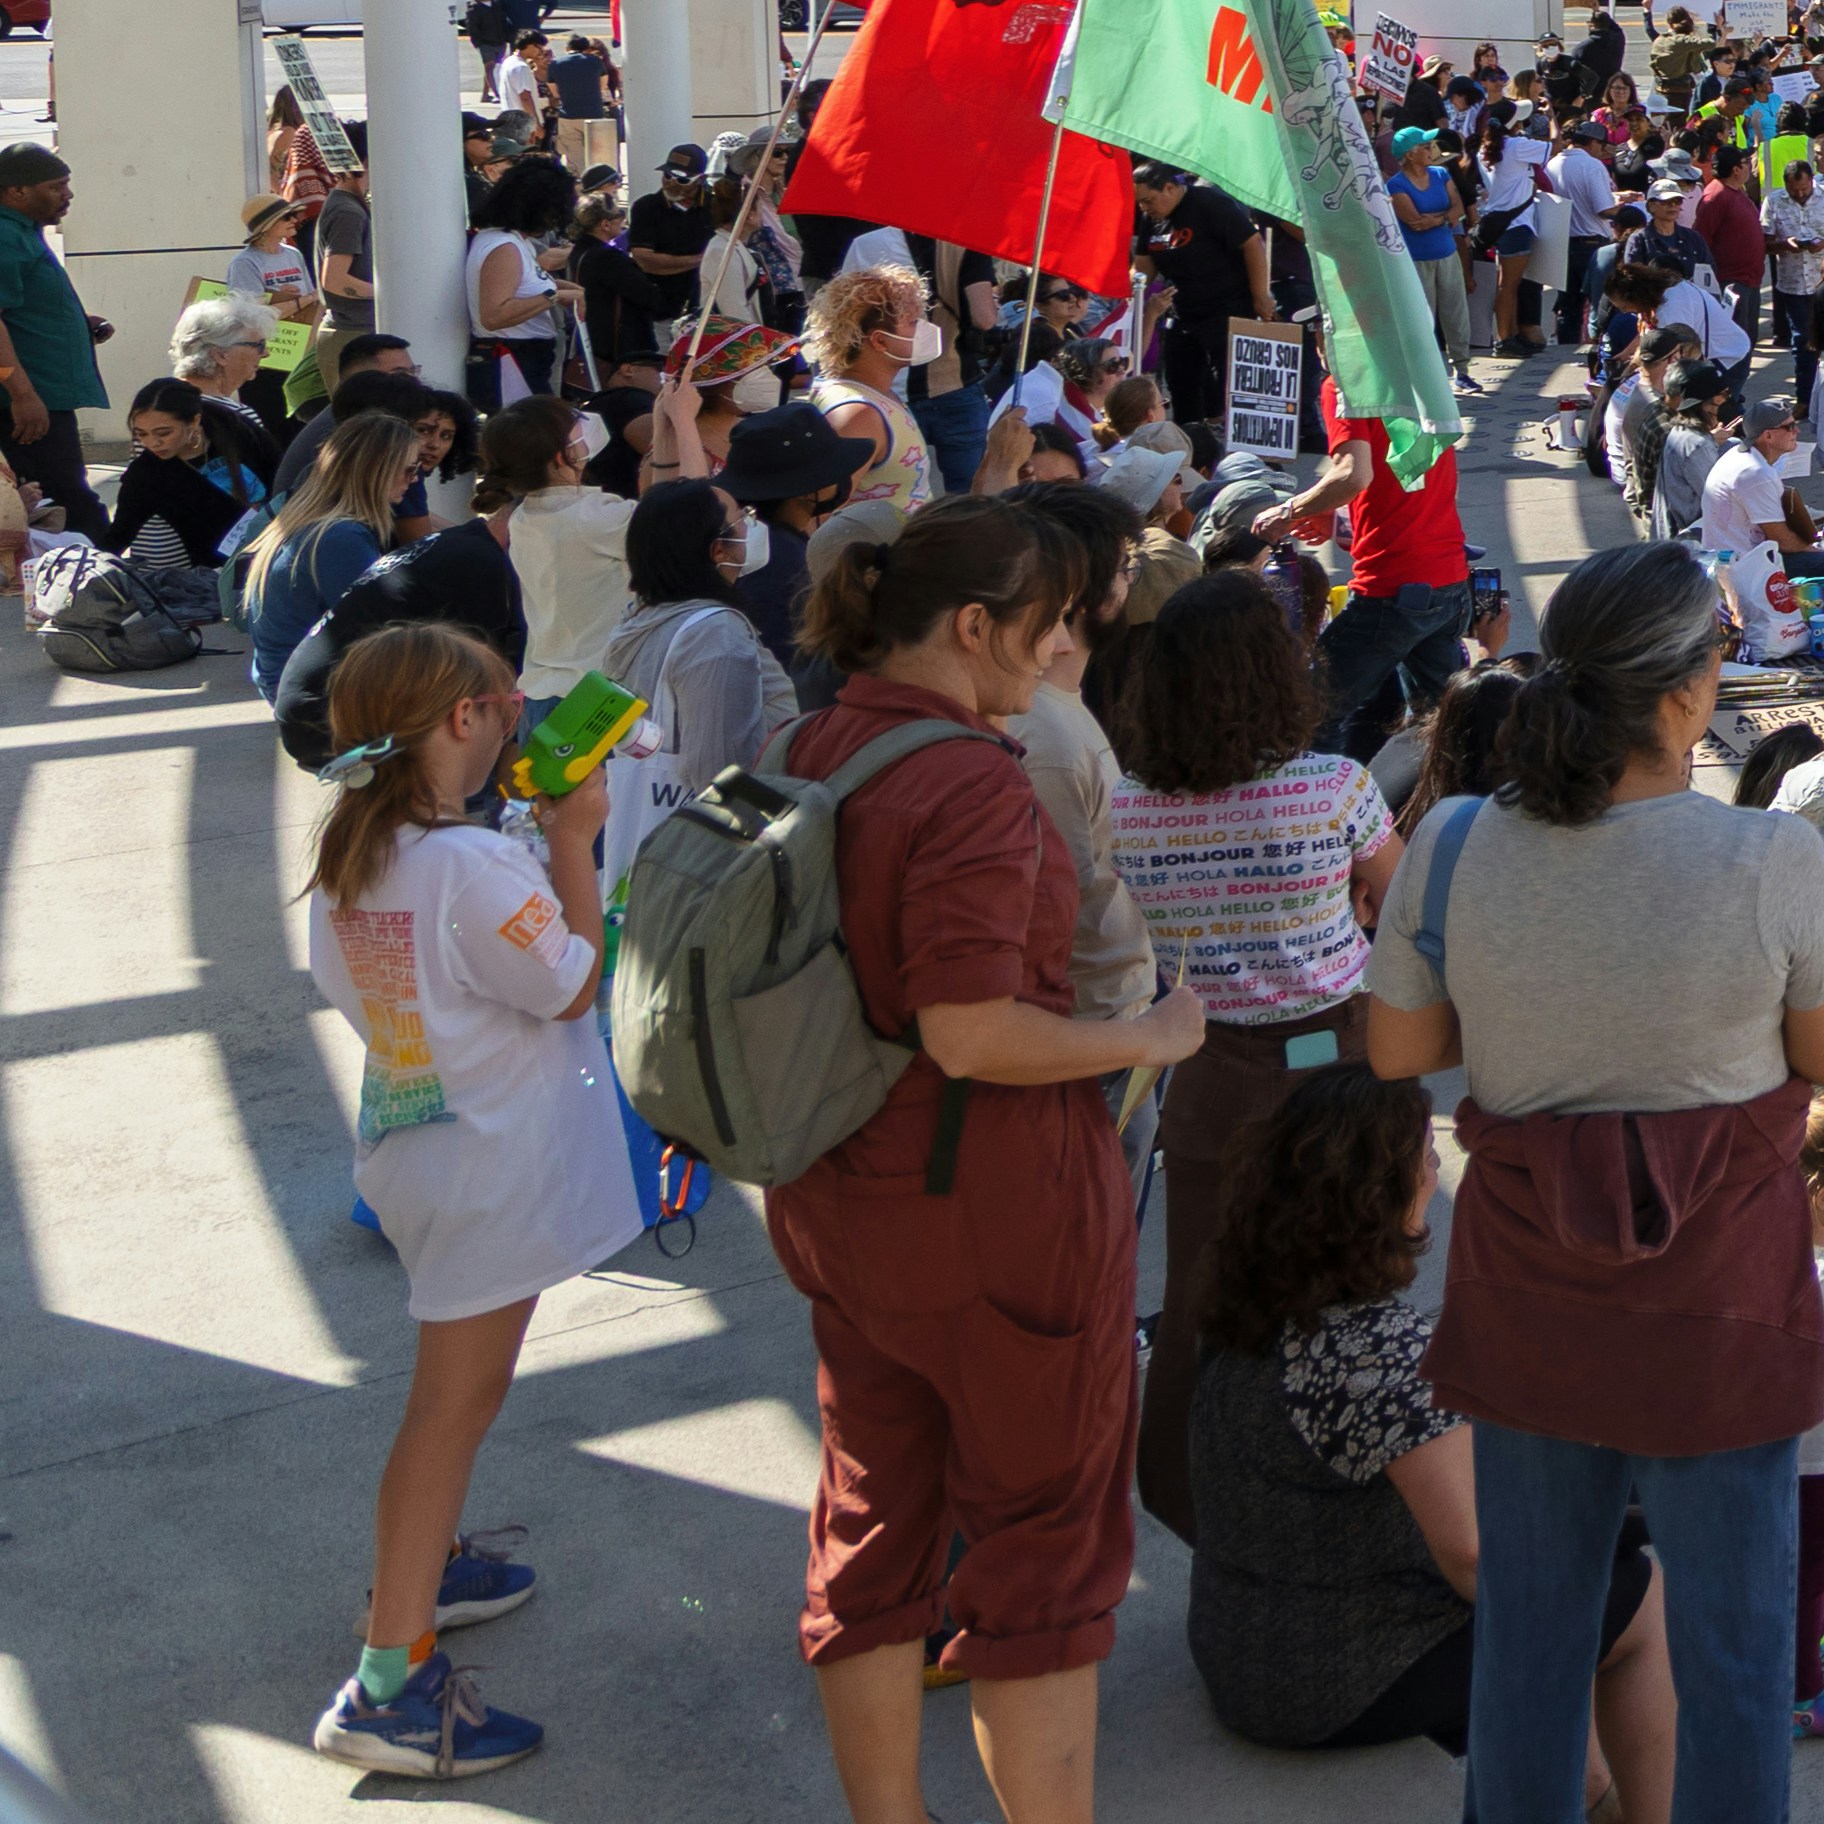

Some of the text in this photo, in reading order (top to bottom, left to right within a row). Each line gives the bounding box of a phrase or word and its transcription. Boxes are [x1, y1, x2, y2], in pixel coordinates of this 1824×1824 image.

[1728, 1, 1785, 12] IMMIGRANTS
[1372, 32, 1412, 66] NO
[1384, 62, 1406, 78] LAS
[1235, 338, 1272, 366] CRUZO
[1235, 364, 1282, 398] FRONTERA
[1239, 782, 1309, 801] HALLO
[1132, 795, 1185, 809] HELLO
[1121, 800, 1333, 831] BONJOUR HOLA HELLO
[1167, 831, 1228, 847] HELLO
[1151, 848, 1254, 867] BONJOUR
[1176, 862, 1304, 883] HOLA HALLO
[1227, 877, 1329, 896] BONJOUR
[1171, 900, 1275, 920] HOLA HELLO
[509, 898, 555, 947] nea
[1250, 916, 1305, 933] HELLO
[1194, 926, 1336, 957] BONJOUR HELLO
[1189, 961, 1241, 976] HALLO
[1265, 972, 1306, 987] HOLA
[1207, 991, 1288, 1011] BONJOUR
